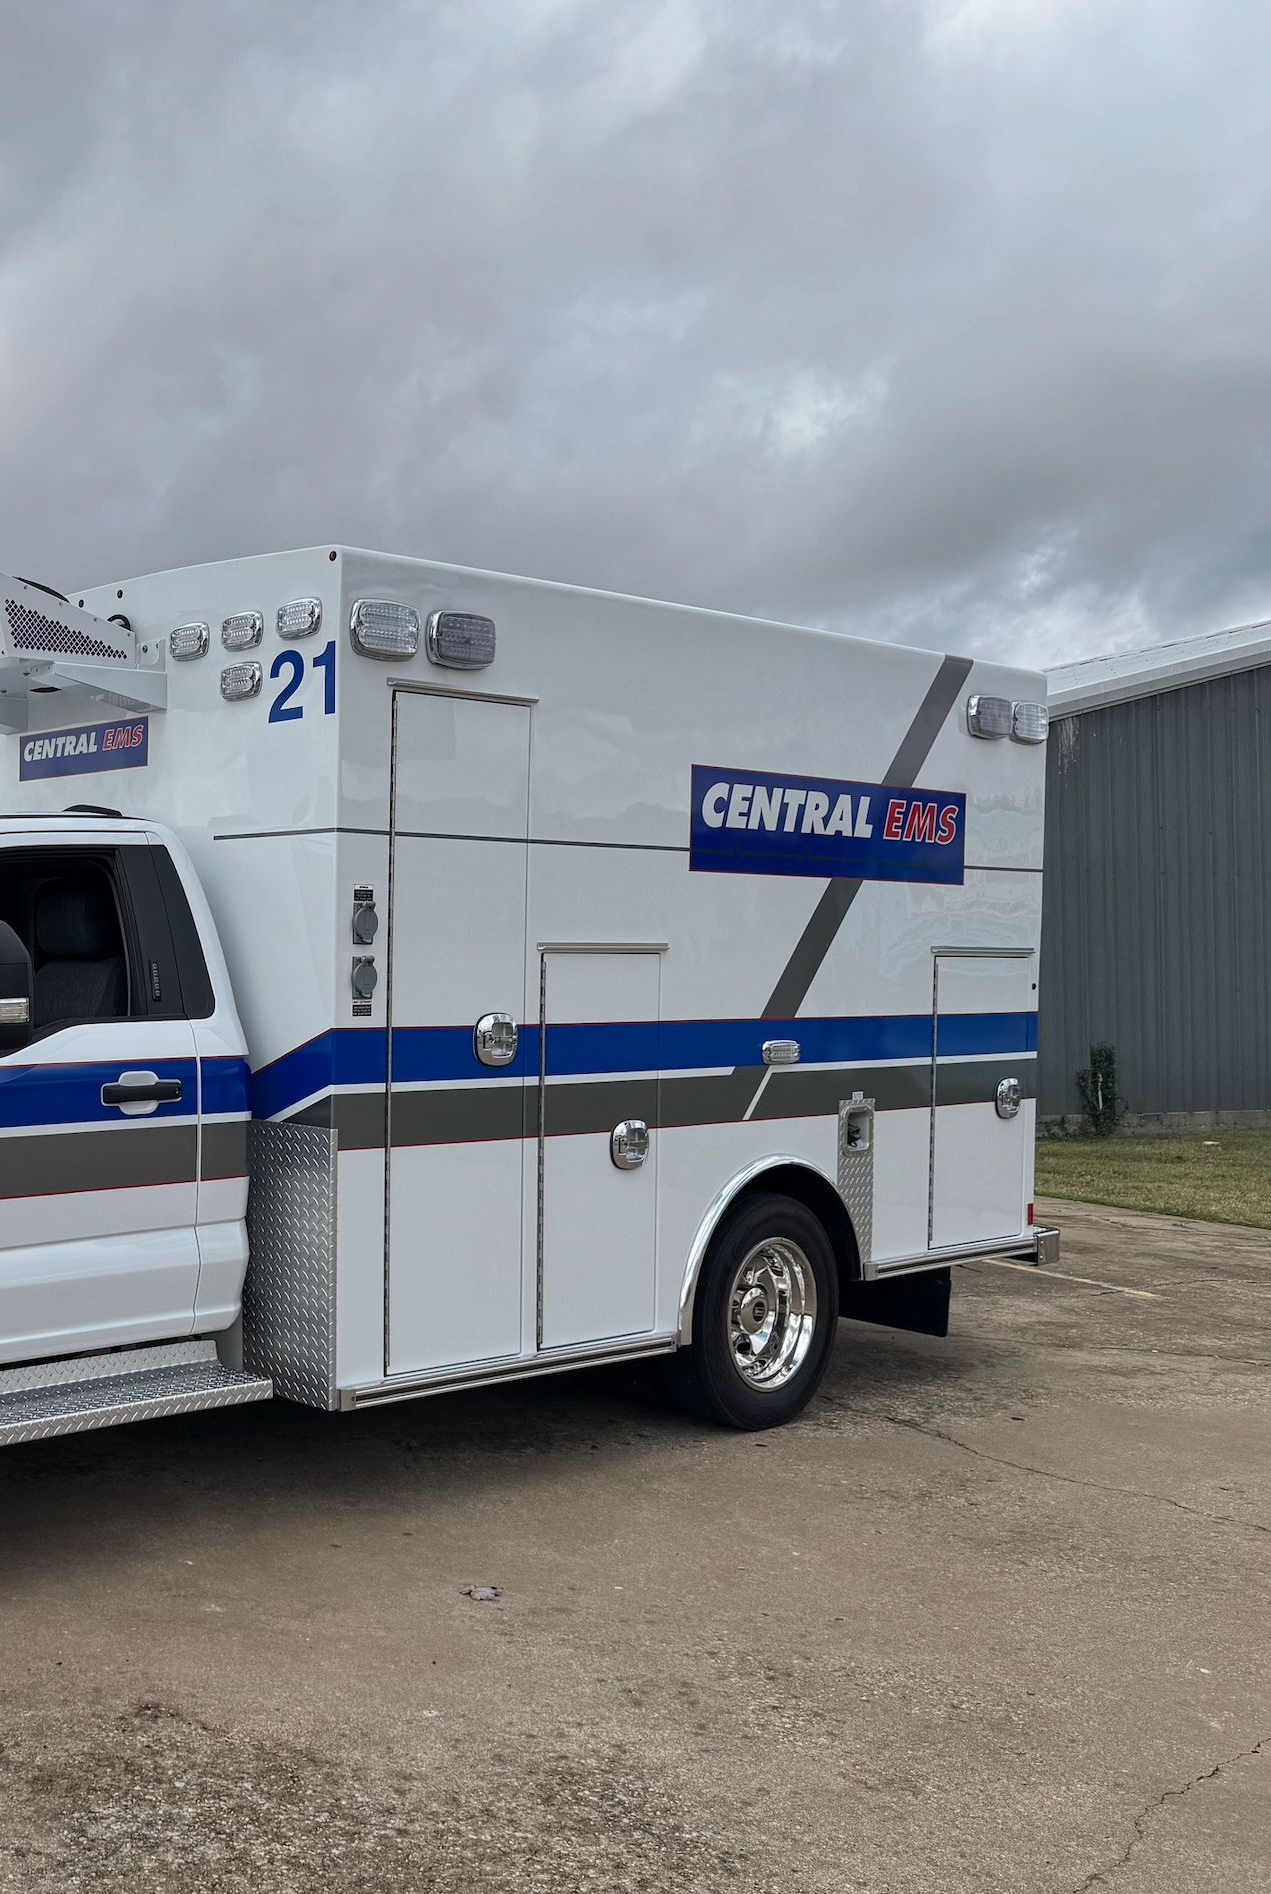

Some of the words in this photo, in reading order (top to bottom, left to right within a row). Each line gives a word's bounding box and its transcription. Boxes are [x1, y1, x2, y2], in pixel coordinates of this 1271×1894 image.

[268, 640, 336, 724] 21
[23, 736, 98, 763] CENTRAL
[102, 723, 144, 752] EMS
[702, 782, 874, 839] CENTRAL
[883, 799, 960, 845] EMS
